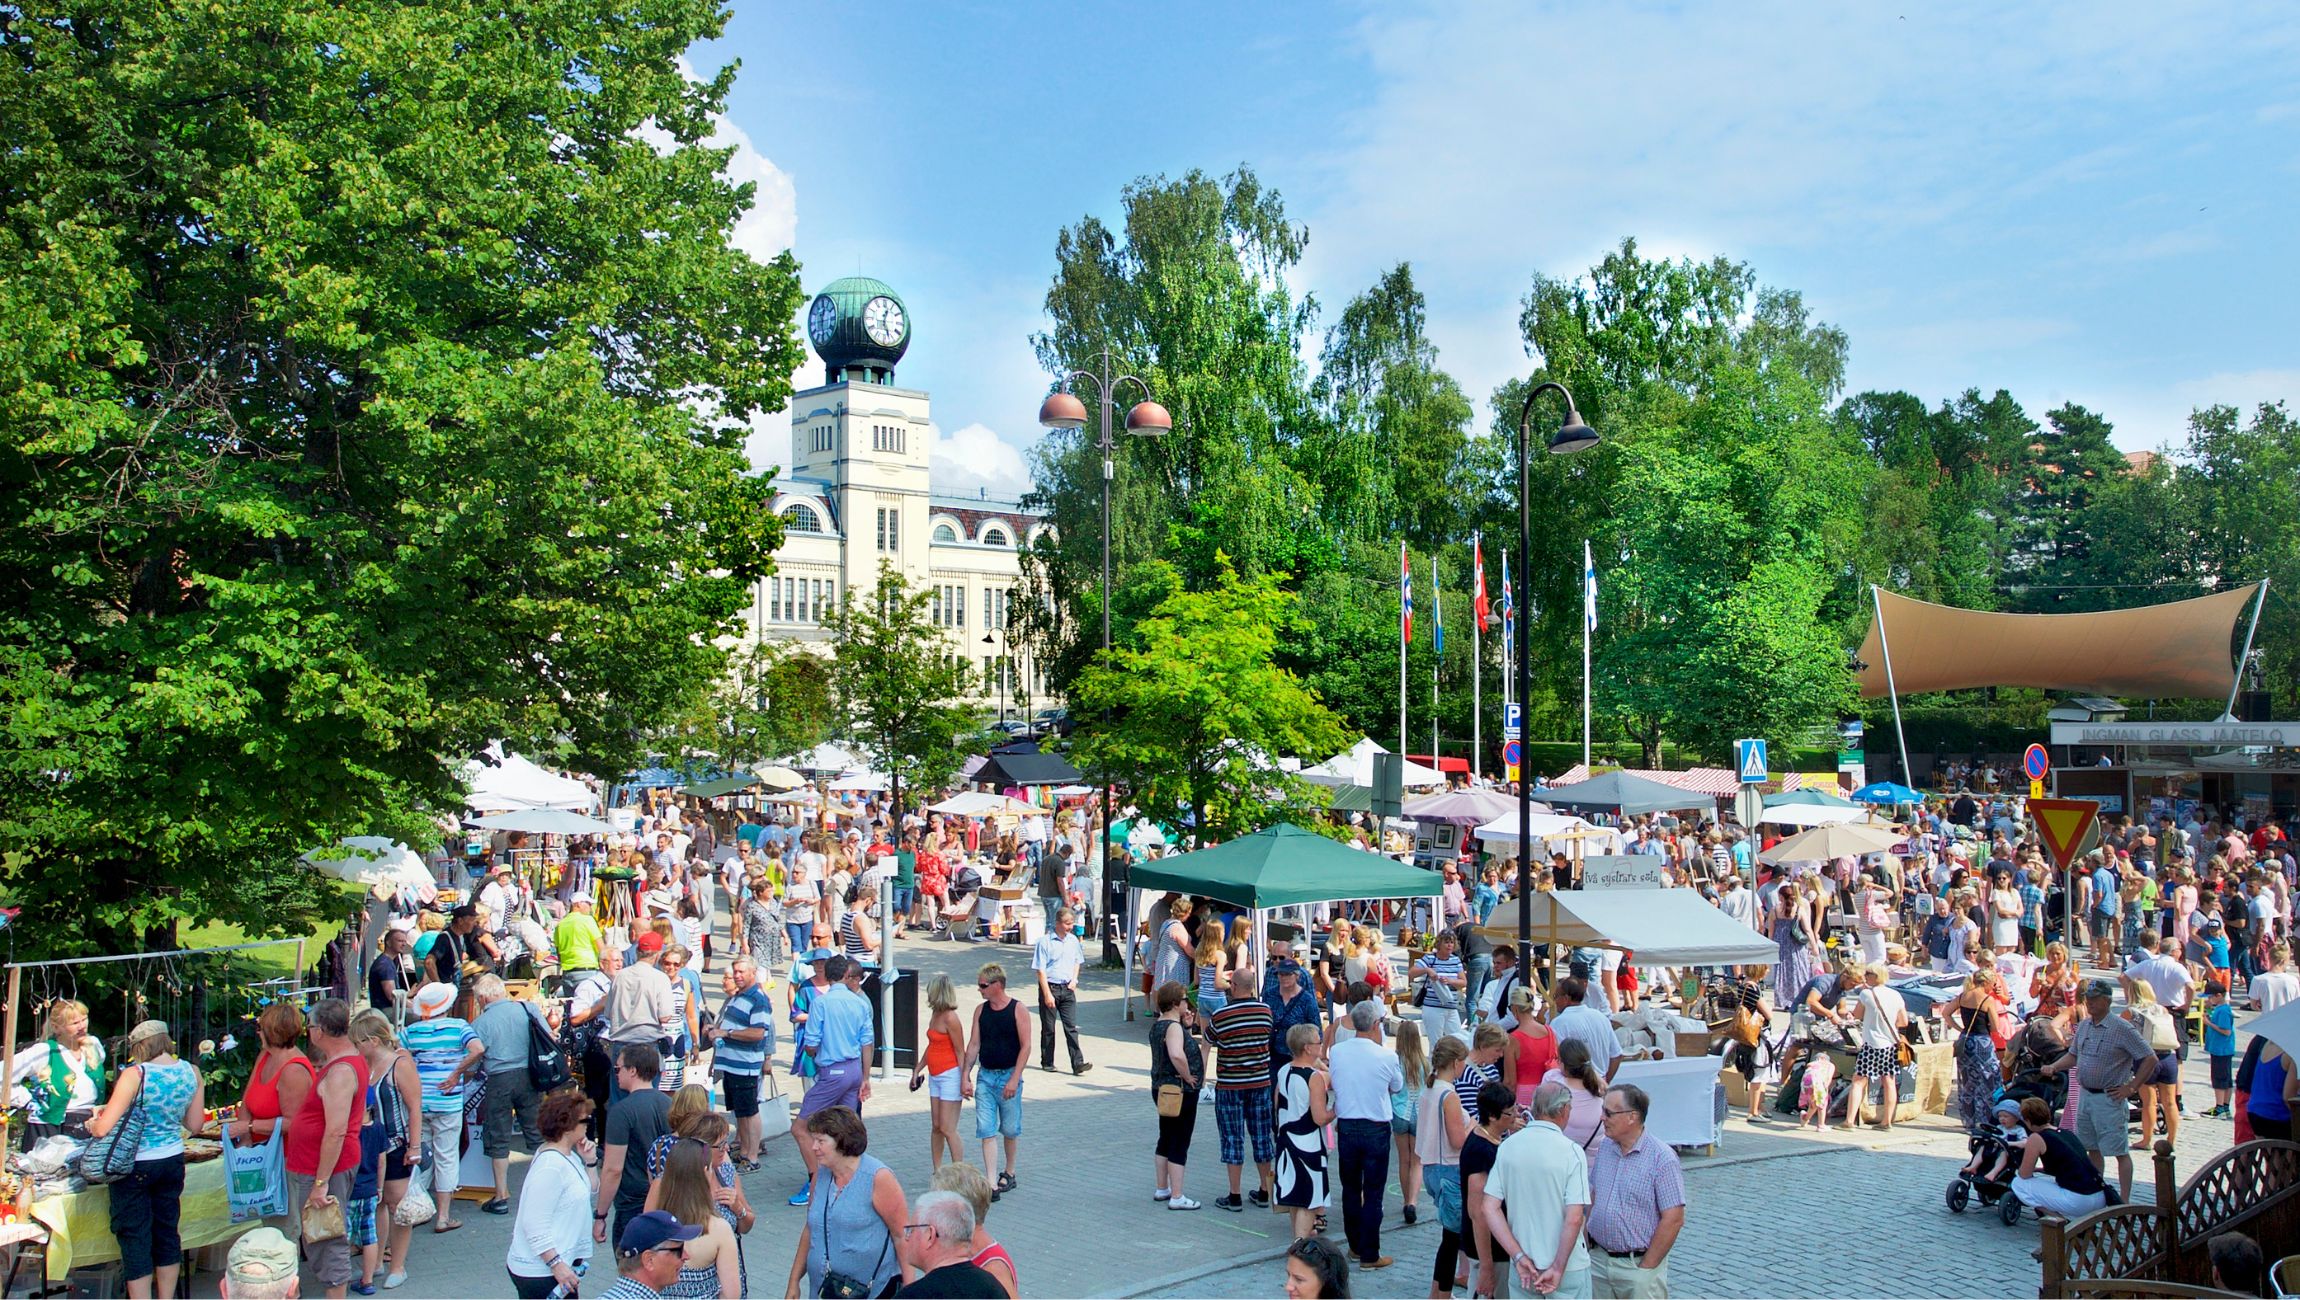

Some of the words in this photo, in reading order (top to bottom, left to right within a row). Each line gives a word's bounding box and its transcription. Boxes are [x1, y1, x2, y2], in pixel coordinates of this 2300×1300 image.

[1508, 705, 1521, 727] P
[2082, 729, 2140, 741] INGMAN
[2148, 729, 2201, 741] GLASS
